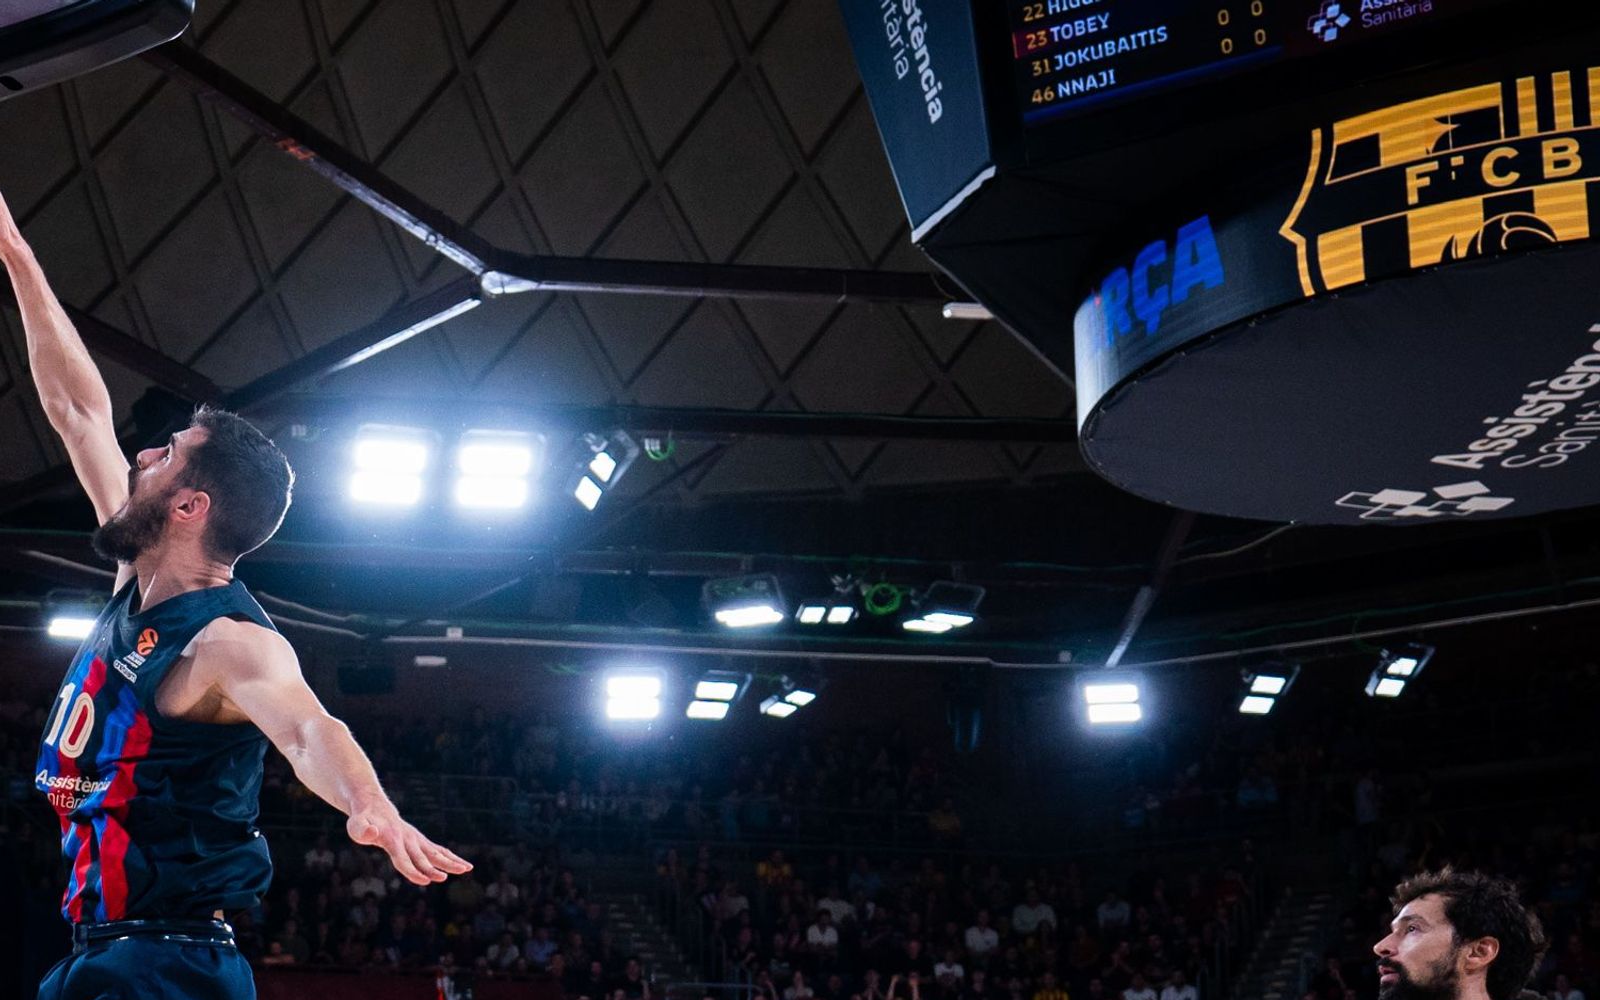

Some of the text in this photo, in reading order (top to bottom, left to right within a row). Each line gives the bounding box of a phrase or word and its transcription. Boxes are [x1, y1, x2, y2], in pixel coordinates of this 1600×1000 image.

[1024, 4, 1045, 21] 22
[1026, 13, 1111, 50] 23 TOBEY
[1032, 59, 1052, 76] 31
[1054, 26, 1169, 71] JOKUBAITIS
[1032, 87, 1055, 104] 46
[1057, 69, 1117, 98] NNAJI
[44, 682, 95, 758] 10
